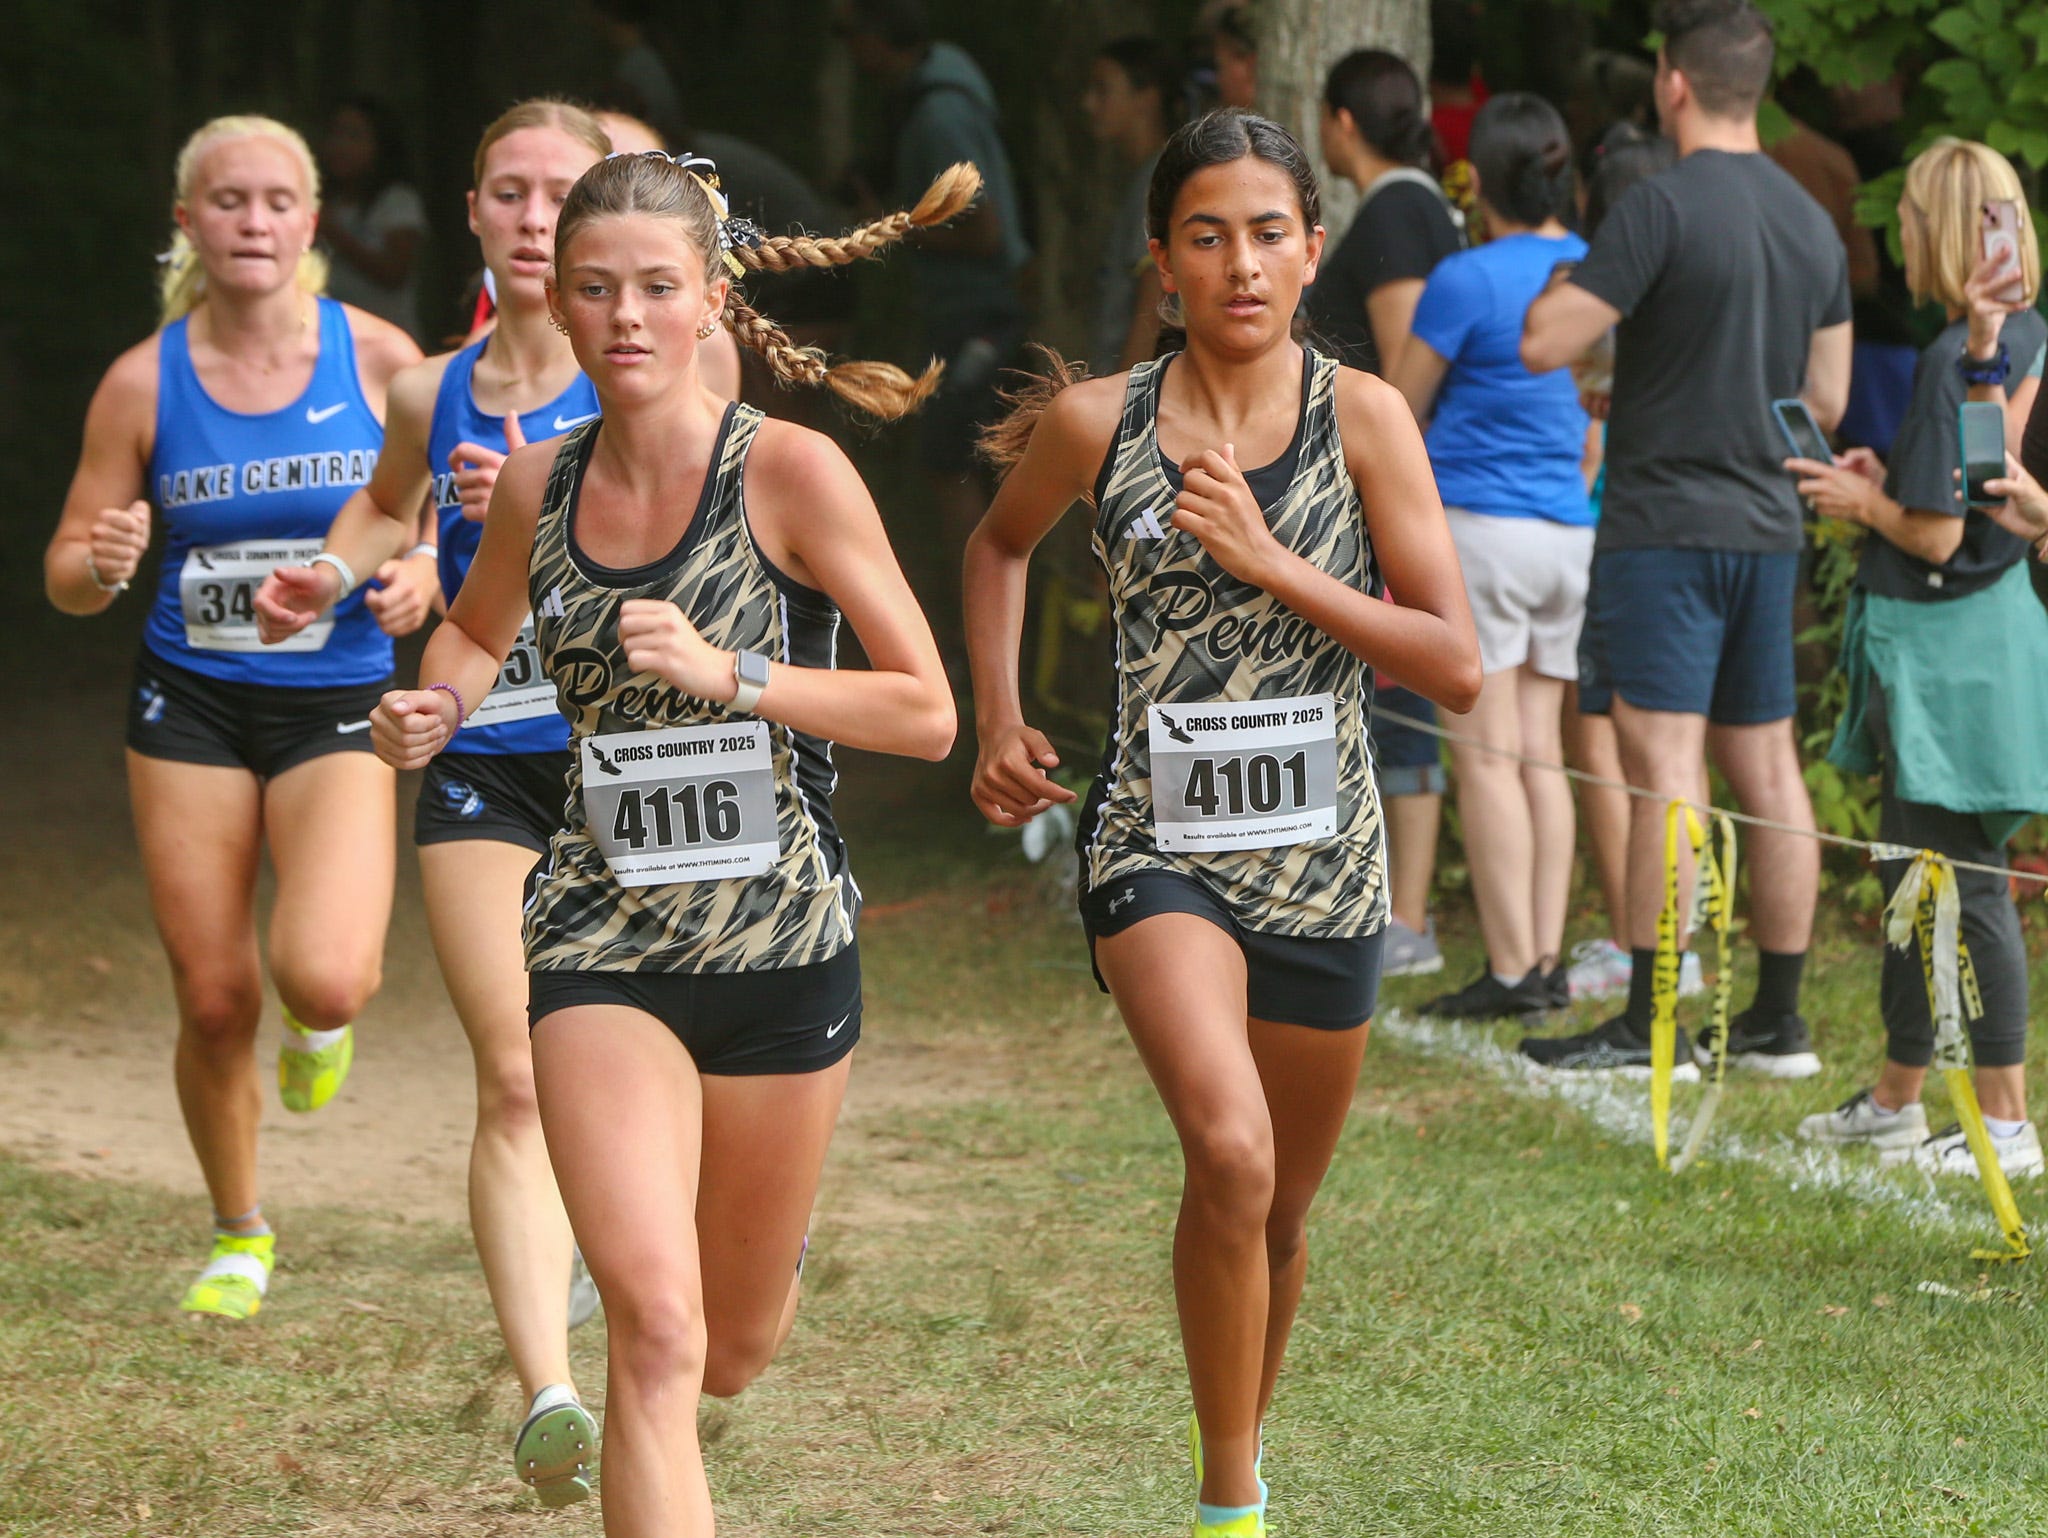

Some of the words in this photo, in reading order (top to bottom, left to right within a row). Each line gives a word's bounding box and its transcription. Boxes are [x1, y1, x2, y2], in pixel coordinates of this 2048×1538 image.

[161, 464, 234, 508] LAKE
[200, 582, 256, 625] 34
[1148, 570, 1325, 661] Penn
[1186, 717, 1227, 732] CROSS
[1231, 712, 1288, 730] COUNTRY
[1292, 707, 1323, 724] 2025
[614, 745, 653, 763] CROSS
[657, 739, 715, 758] COUNTRY
[719, 735, 756, 752] 2025
[1183, 750, 1307, 816] 4101
[613, 779, 742, 850] 4116
[1207, 830, 1237, 840] available
[636, 864, 667, 873] available
[677, 856, 750, 869] WWW.THTIMING.COM
